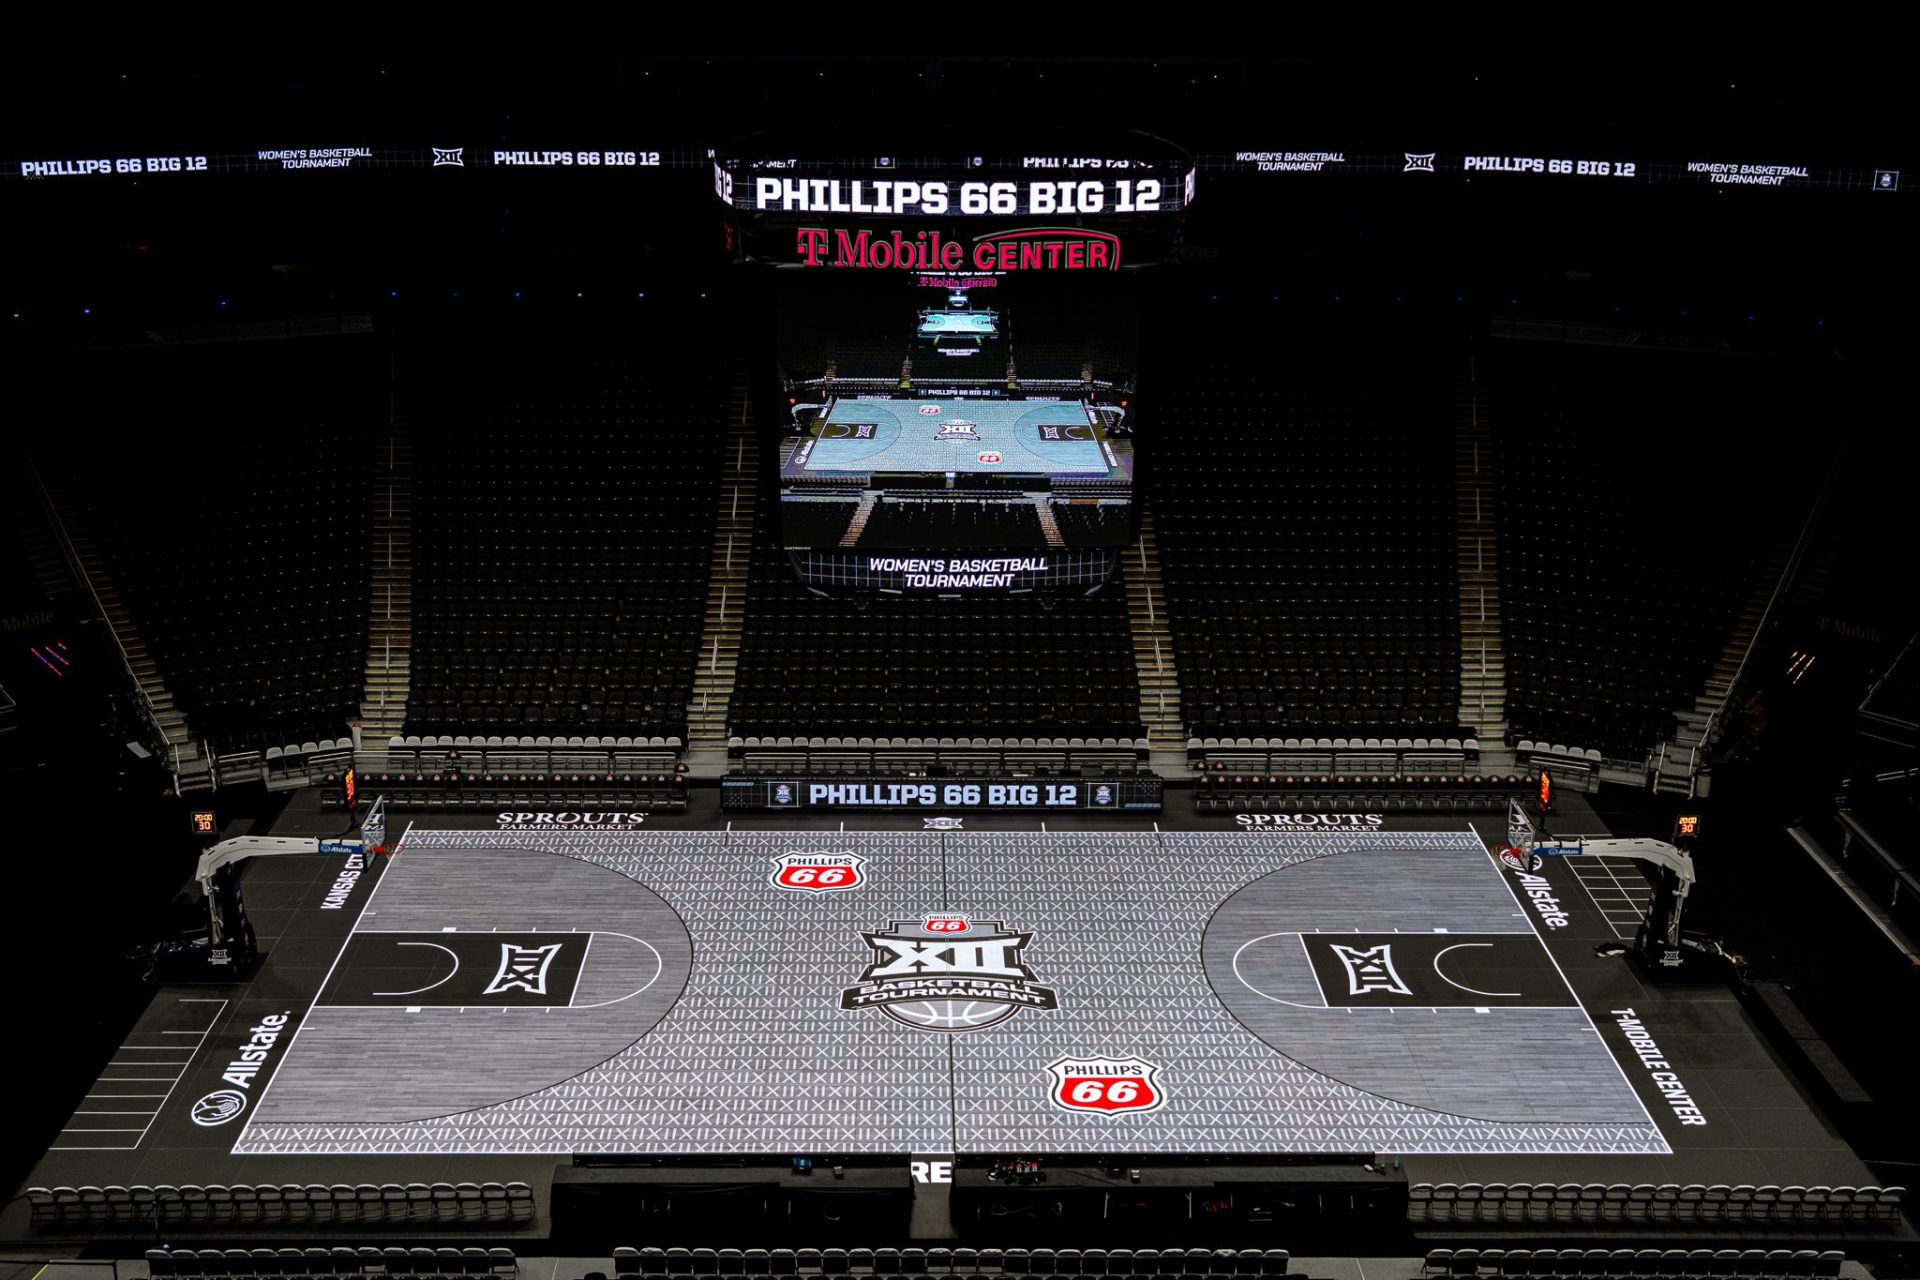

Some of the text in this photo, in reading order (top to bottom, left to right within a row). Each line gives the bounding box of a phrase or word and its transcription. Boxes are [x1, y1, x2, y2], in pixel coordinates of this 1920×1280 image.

[258, 148, 373, 160] WOMEN'S BASKETBALL
[494, 151, 660, 166] PHILLIPS 66 BIG 12
[1236, 152, 1345, 162] WOMEN'S BASKETBALL
[21, 157, 207, 176] PHILLIPS 66 BIG 12
[282, 158, 351, 169] TOURNAMENT
[1257, 161, 1324, 171] TOURNAMENT
[1464, 156, 1636, 177] PHILLIPS 66 BIG 12
[1687, 161, 1809, 178] WOMEN'S BASKETBALL
[1710, 173, 1785, 186] TOURNAMENT
[757, 178, 948, 214] PHILLIPS
[960, 183, 1017, 214] 66
[1029, 181, 1104, 214] BIG
[1115, 180, 1161, 212] 12
[973, 241, 1108, 271] CENTER
[870, 557, 1049, 573] WOMEN'S BASKETBALL
[905, 574, 1015, 588] TOURNAMENT
[810, 784, 936, 805] PHILLIPS
[944, 784, 980, 805] 66
[988, 784, 1038, 805] BIG
[1045, 785, 1077, 805] 12
[199, 821, 211, 830] 30
[496, 812, 644, 824] SPROUTS
[1235, 813, 1383, 825] SPROUTS
[1682, 824, 1694, 832] 30
[787, 857, 853, 865] PHILLIPS
[789, 868, 847, 884] 66
[320, 871, 361, 909] KANSAS
[930, 921, 961, 930] 66
[860, 978, 1040, 996] BASKETBALL
[853, 987, 1046, 1004] TOURNAMENT
[1063, 1064, 1143, 1076] PHILLIPS
[1610, 1008, 1707, 1125] T-MOBILE CENTER
[1071, 1081, 1140, 1103] 66
